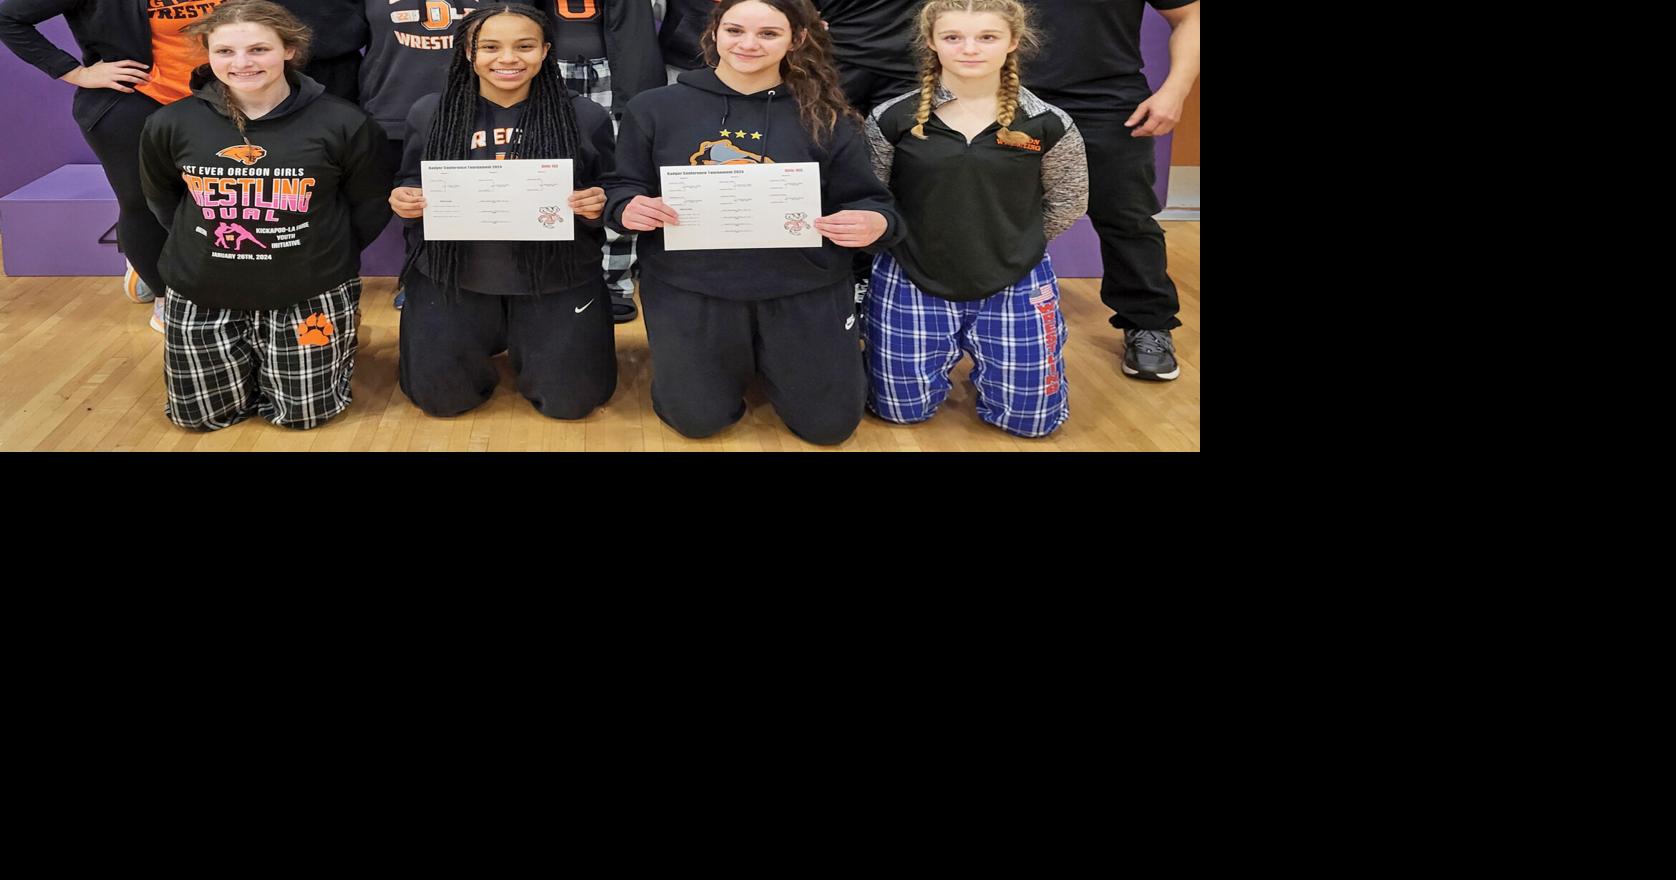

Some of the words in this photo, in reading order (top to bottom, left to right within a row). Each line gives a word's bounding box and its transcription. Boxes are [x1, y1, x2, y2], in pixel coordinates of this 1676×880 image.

[199, 166, 224, 176] EVER
[227, 167, 270, 177] OREGON
[274, 167, 305, 177] GIRLS
[202, 207, 280, 222] DUAL
